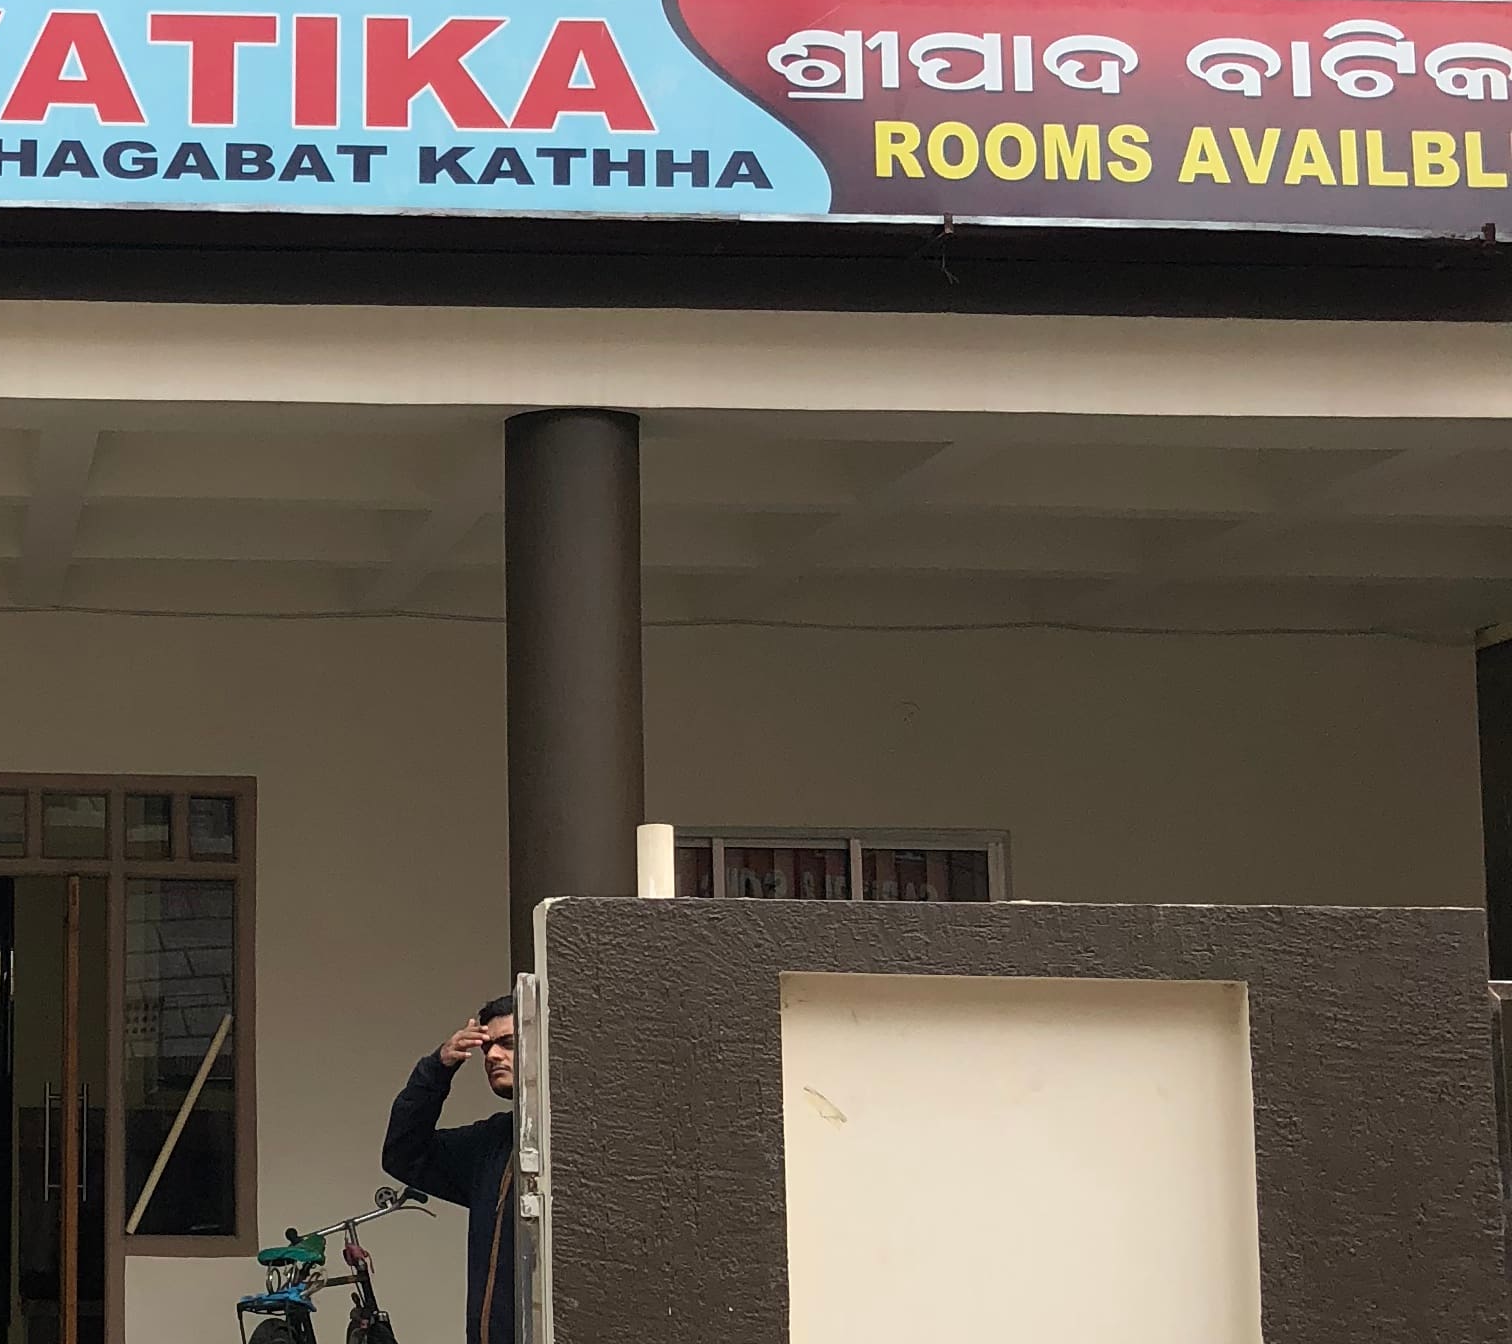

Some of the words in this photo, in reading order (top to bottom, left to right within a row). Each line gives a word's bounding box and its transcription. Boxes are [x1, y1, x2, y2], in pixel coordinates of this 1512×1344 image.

[767, 29, 1140, 100] ଶ୍ରୀପାଦ
[417, 145, 775, 190] KATHHA
[873, 120, 1153, 183] ROOMS
[1177, 125, 1512, 189] AVAILBL
